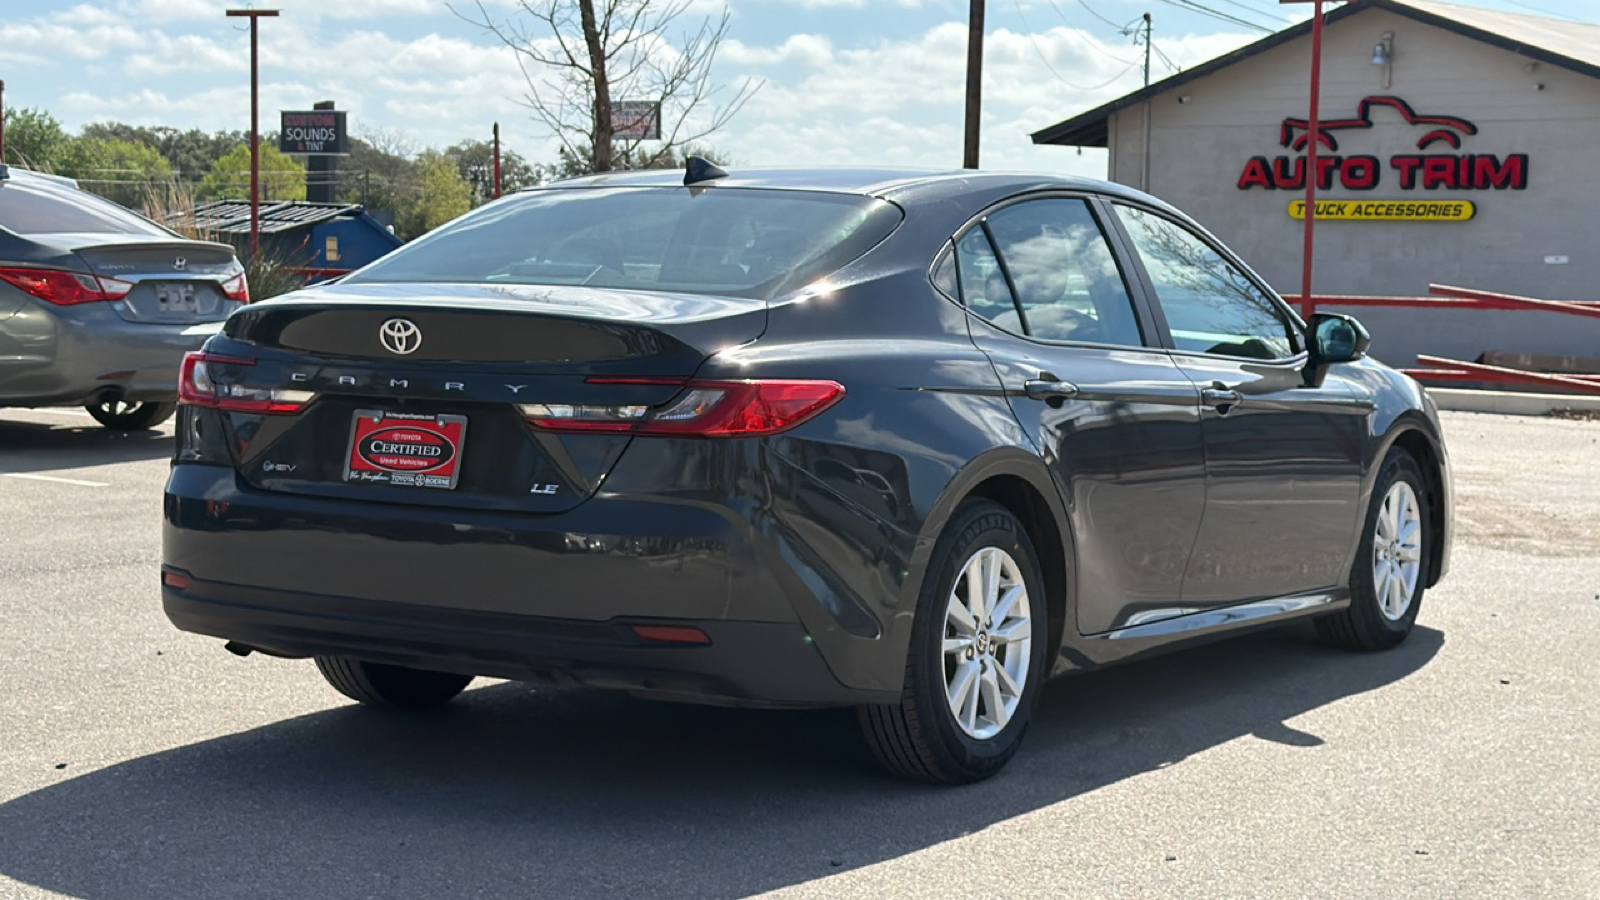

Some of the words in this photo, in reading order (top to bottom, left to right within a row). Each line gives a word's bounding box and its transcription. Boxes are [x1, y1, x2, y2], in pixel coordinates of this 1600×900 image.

[285, 128, 335, 140] SOUNDS
[306, 141, 324, 150] TINT
[1237, 155, 1379, 190] AUTO
[1390, 153, 1529, 190] TRIM
[1296, 203, 1347, 215] TUCK
[1351, 203, 1464, 216] ACCESSORIES
[291, 373, 529, 393] CAMRY
[400, 433, 421, 441] TOYOTA
[380, 456, 398, 465] Used
[400, 458, 428, 467] Vehicles
[530, 483, 559, 495] LE
